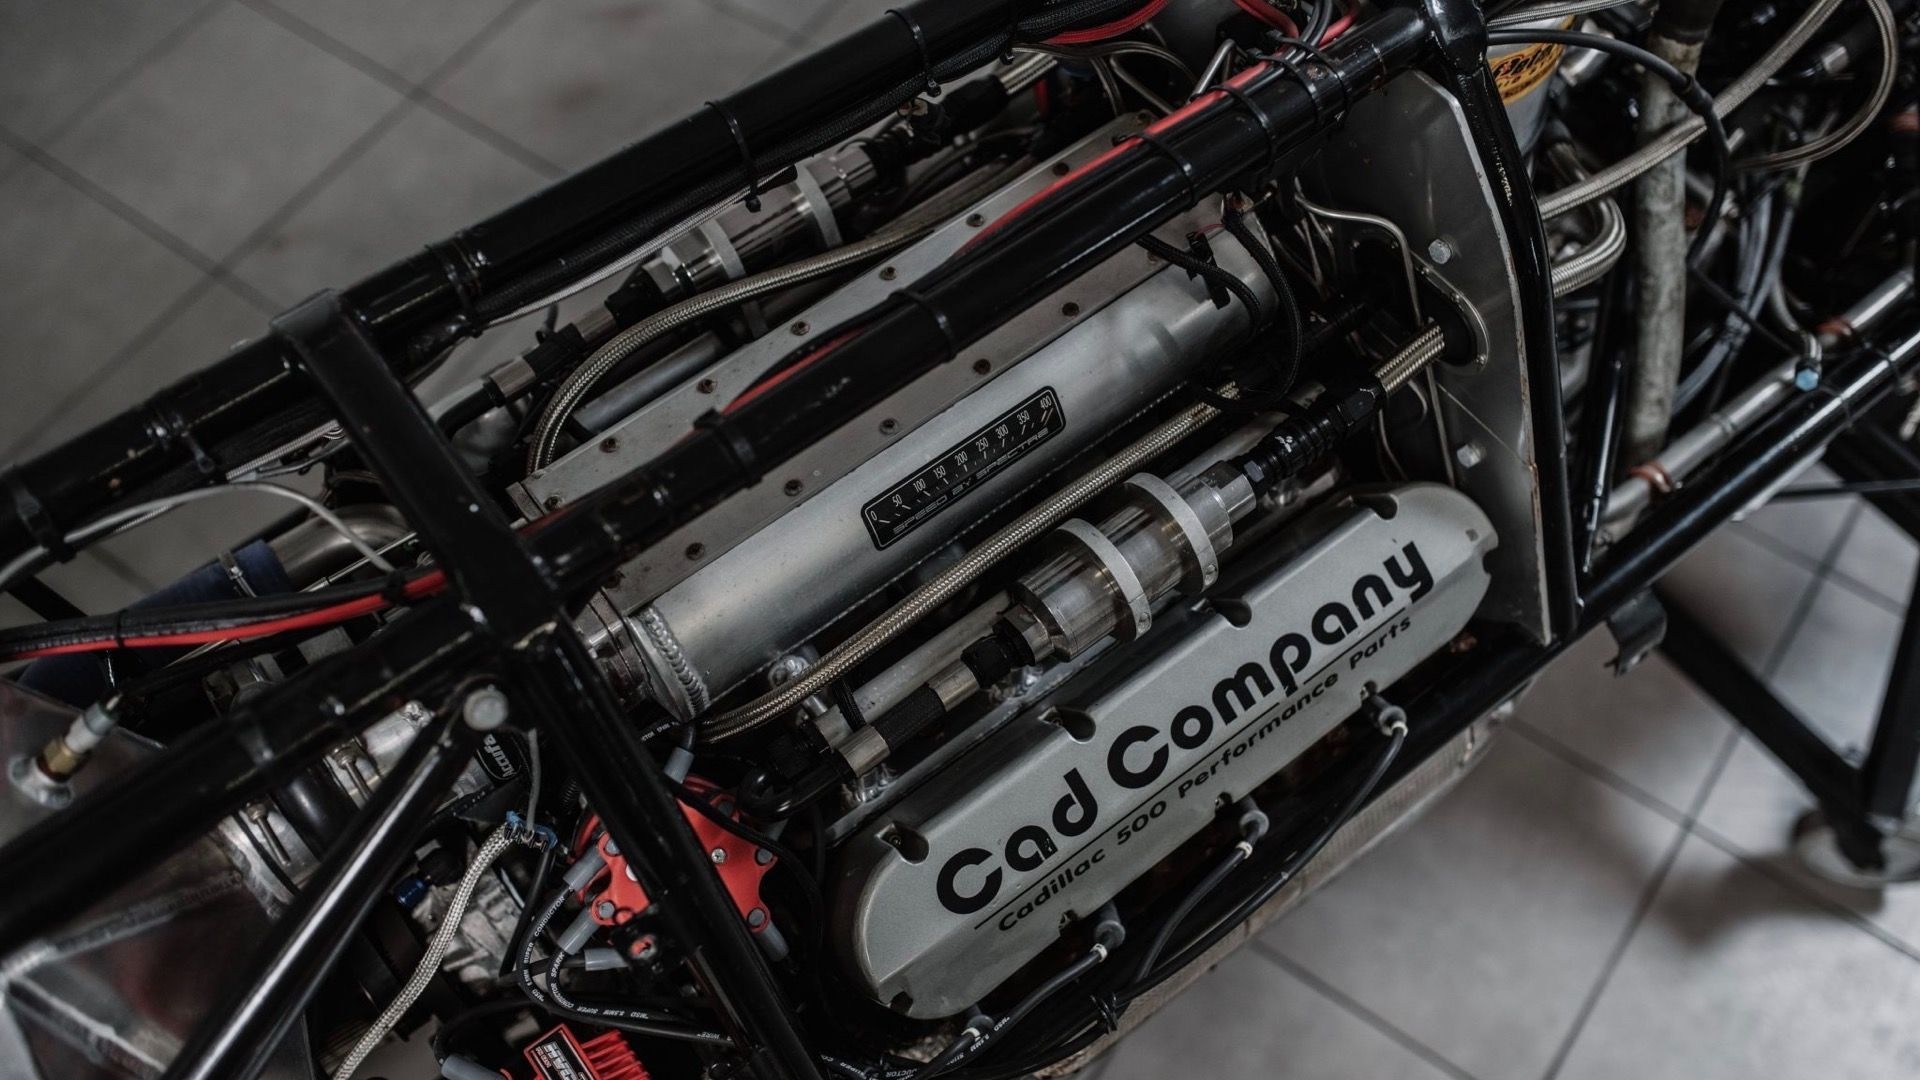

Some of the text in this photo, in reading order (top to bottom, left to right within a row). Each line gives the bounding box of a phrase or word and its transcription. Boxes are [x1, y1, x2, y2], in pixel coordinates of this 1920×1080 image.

[870, 395, 1052, 521] 0 50 100 150 200 250 300 350 400
[893, 495, 947, 534] SPEED
[975, 427, 1049, 480] SPECTRE
[483, 733, 515, 778] Accufa
[936, 541, 1434, 915] Cad Company
[1000, 617, 1411, 931] Cadillac 500 Performance Parts
[534, 895, 566, 937] CONDUCTOR
[551, 951, 565, 978] SPARK
